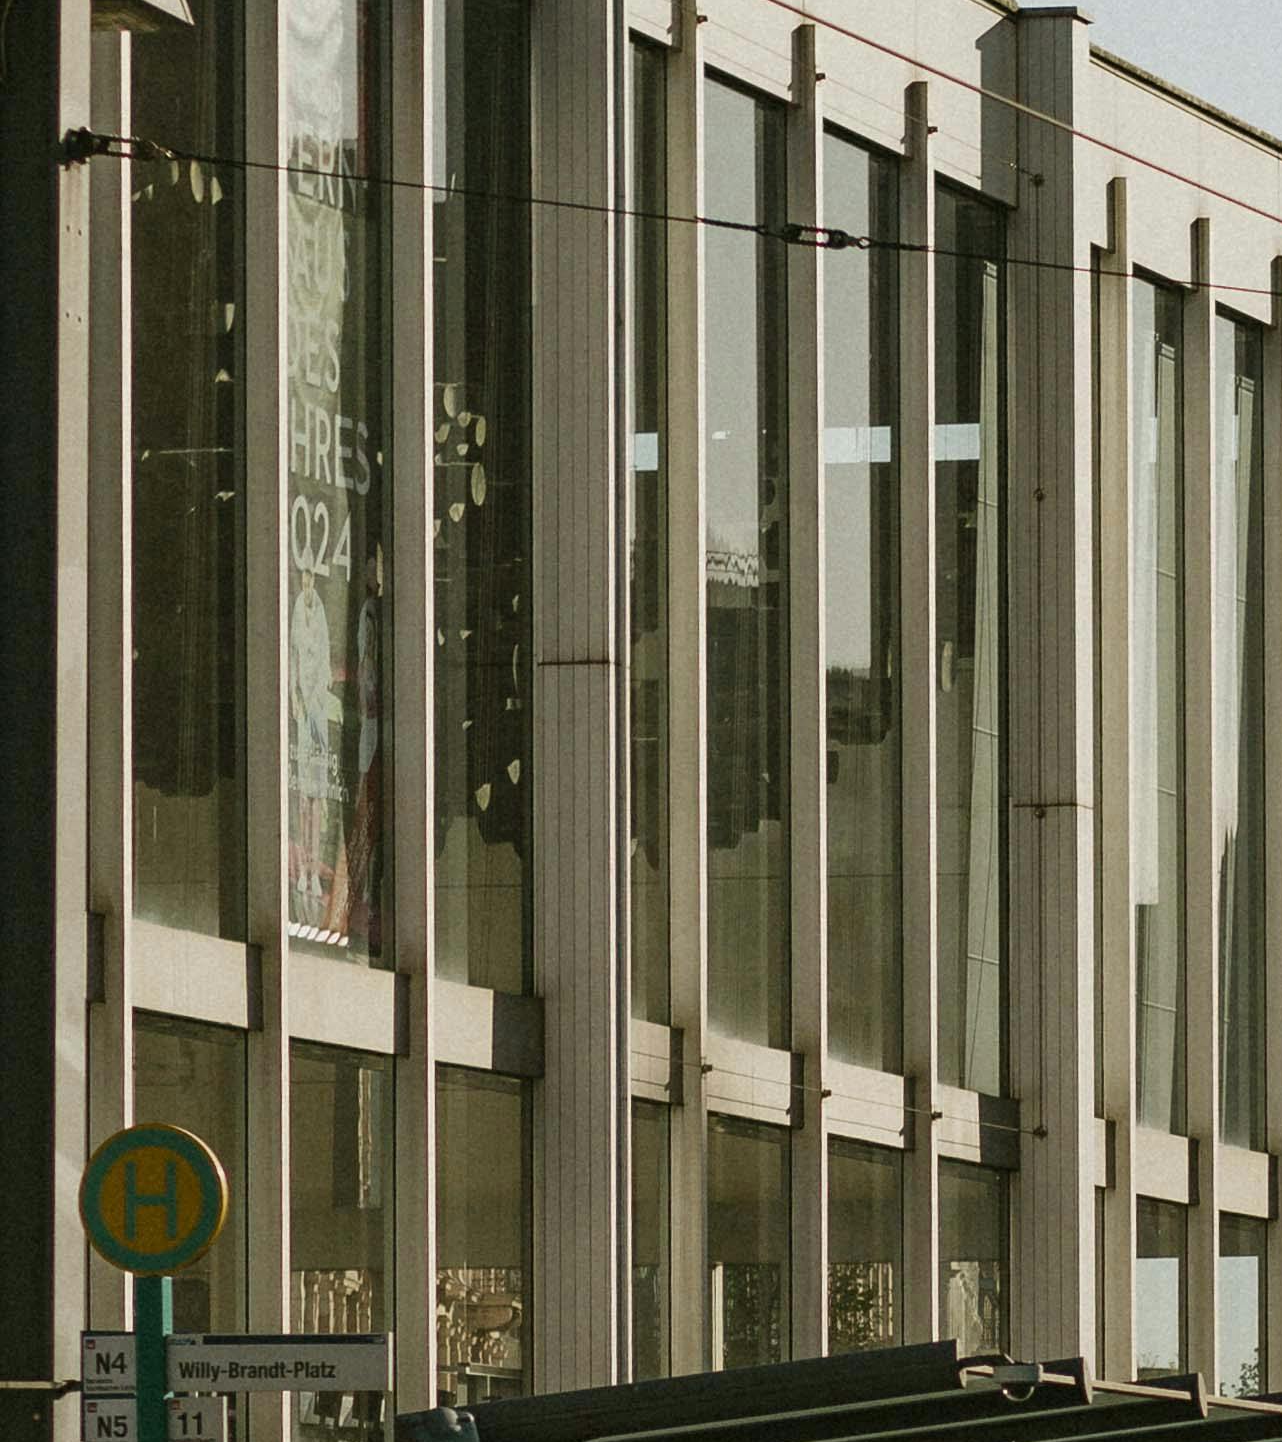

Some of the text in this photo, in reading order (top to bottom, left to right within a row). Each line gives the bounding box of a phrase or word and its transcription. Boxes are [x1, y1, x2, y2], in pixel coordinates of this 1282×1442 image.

[290, 396, 371, 495] HRES
[291, 495, 351, 582] 024
[125, 1161, 177, 1240] H
[96, 1352, 127, 1374] N4
[179, 1361, 337, 1382] Willy-Brandt-Platz
[97, 1415, 128, 1438] N5
[177, 1411, 202, 1435] 11
